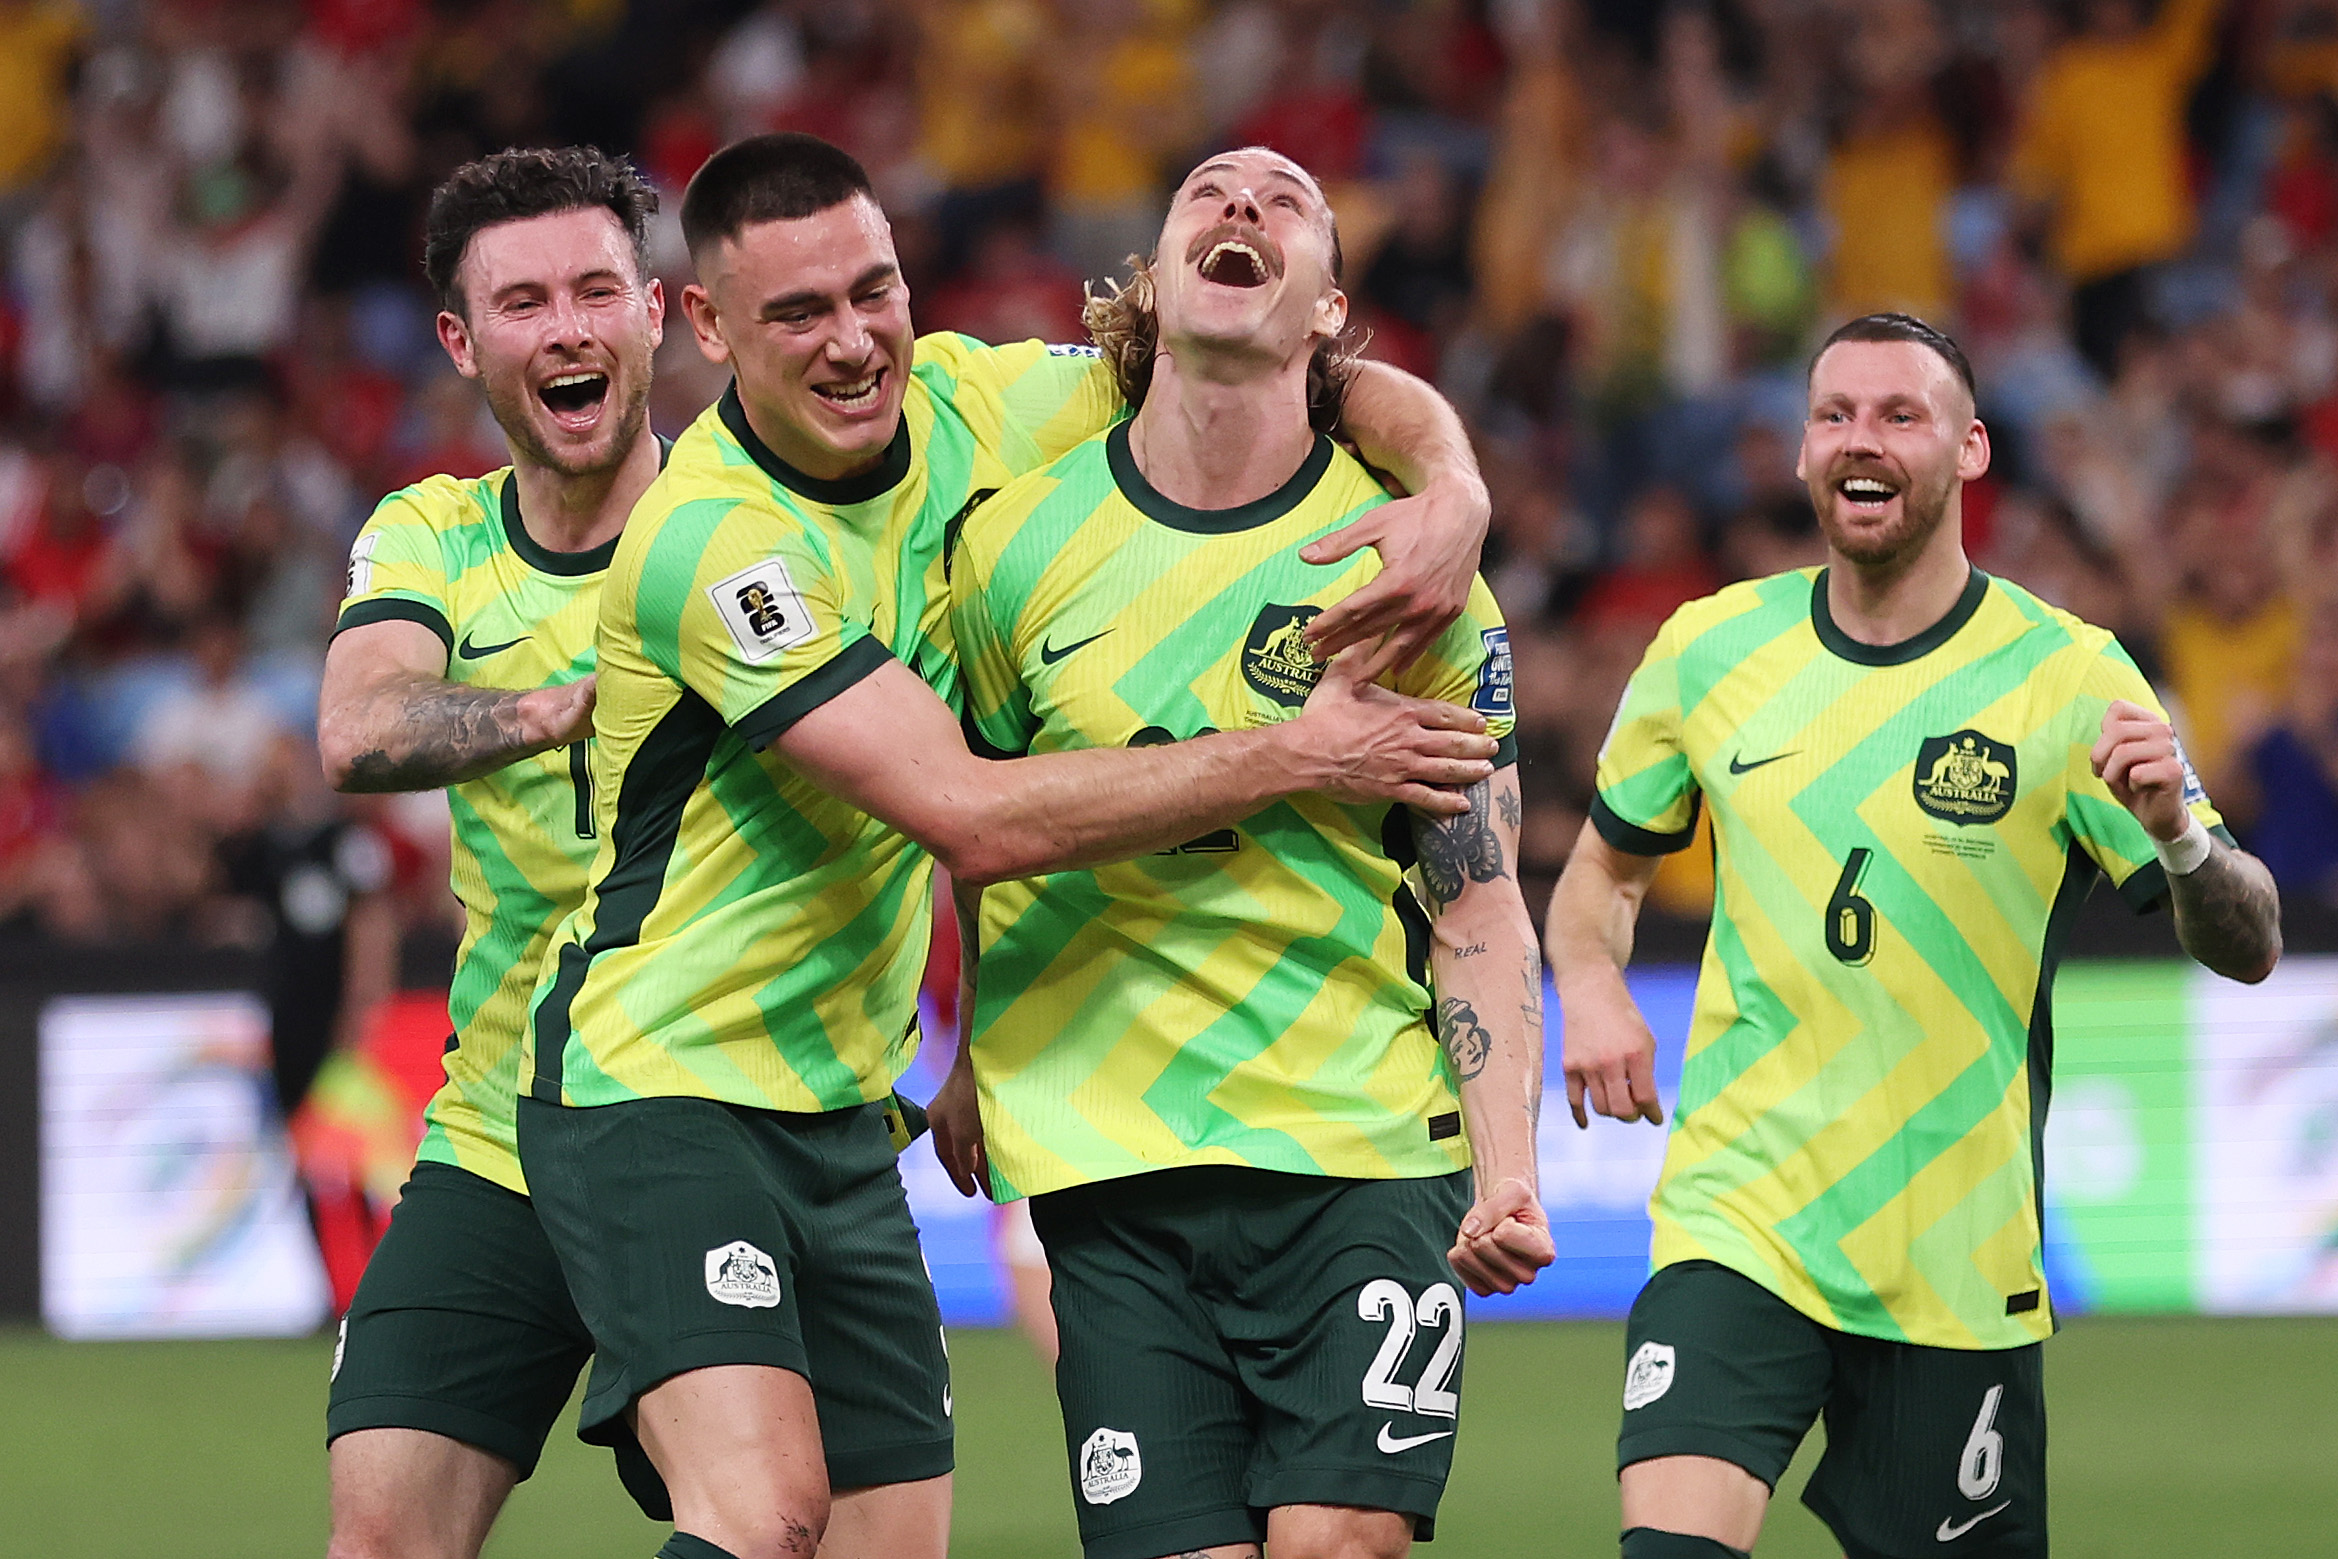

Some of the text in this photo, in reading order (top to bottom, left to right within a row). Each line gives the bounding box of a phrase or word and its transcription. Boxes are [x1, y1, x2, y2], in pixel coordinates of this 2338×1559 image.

[1258, 657, 1318, 683] AUSTRAL
[1930, 785, 1997, 803] AUSTRALIA
[1825, 847, 1878, 968] 6
[1454, 941, 1487, 959] REAL
[721, 1282, 771, 1293] AUSTRALIA
[1358, 1278, 1463, 1421] 22
[1957, 1383, 2004, 1501] 6
[1087, 1473, 1128, 1488] AUSTRALIA
